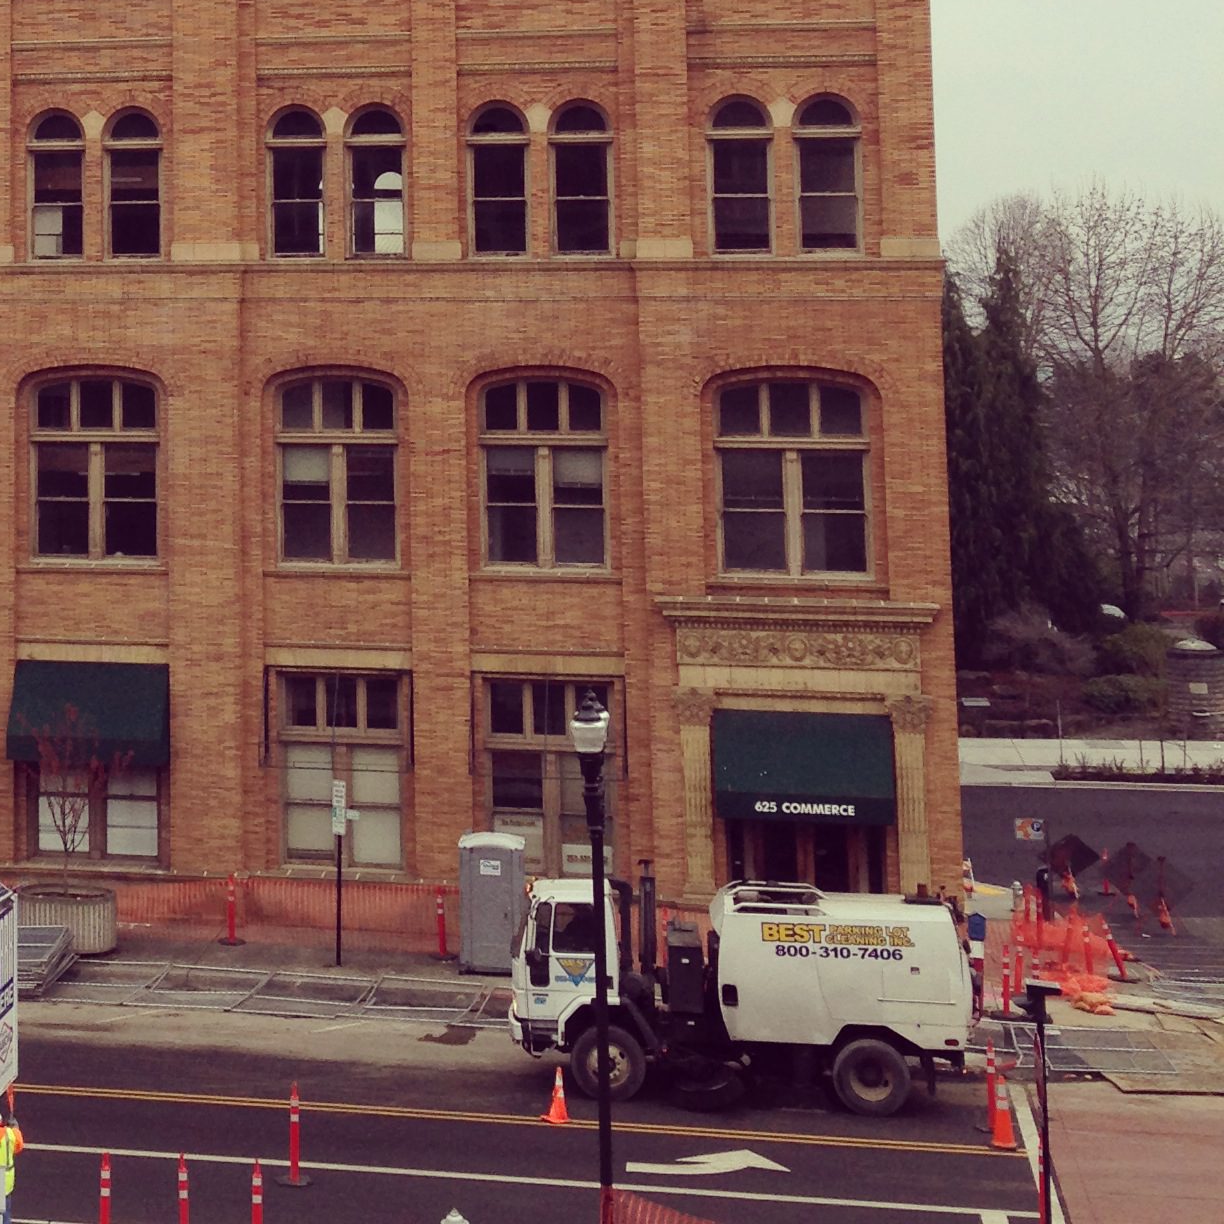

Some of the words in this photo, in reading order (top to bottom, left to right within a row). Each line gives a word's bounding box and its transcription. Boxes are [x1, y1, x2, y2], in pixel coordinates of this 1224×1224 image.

[754, 801, 777, 812] 625
[782, 802, 855, 816] COMMERCE
[761, 922, 826, 943] BEST
[828, 925, 883, 936] PARKING
[885, 926, 910, 937] LOT
[826, 934, 887, 946] CLEANING
[775, 945, 904, 961] 800-310-7406
